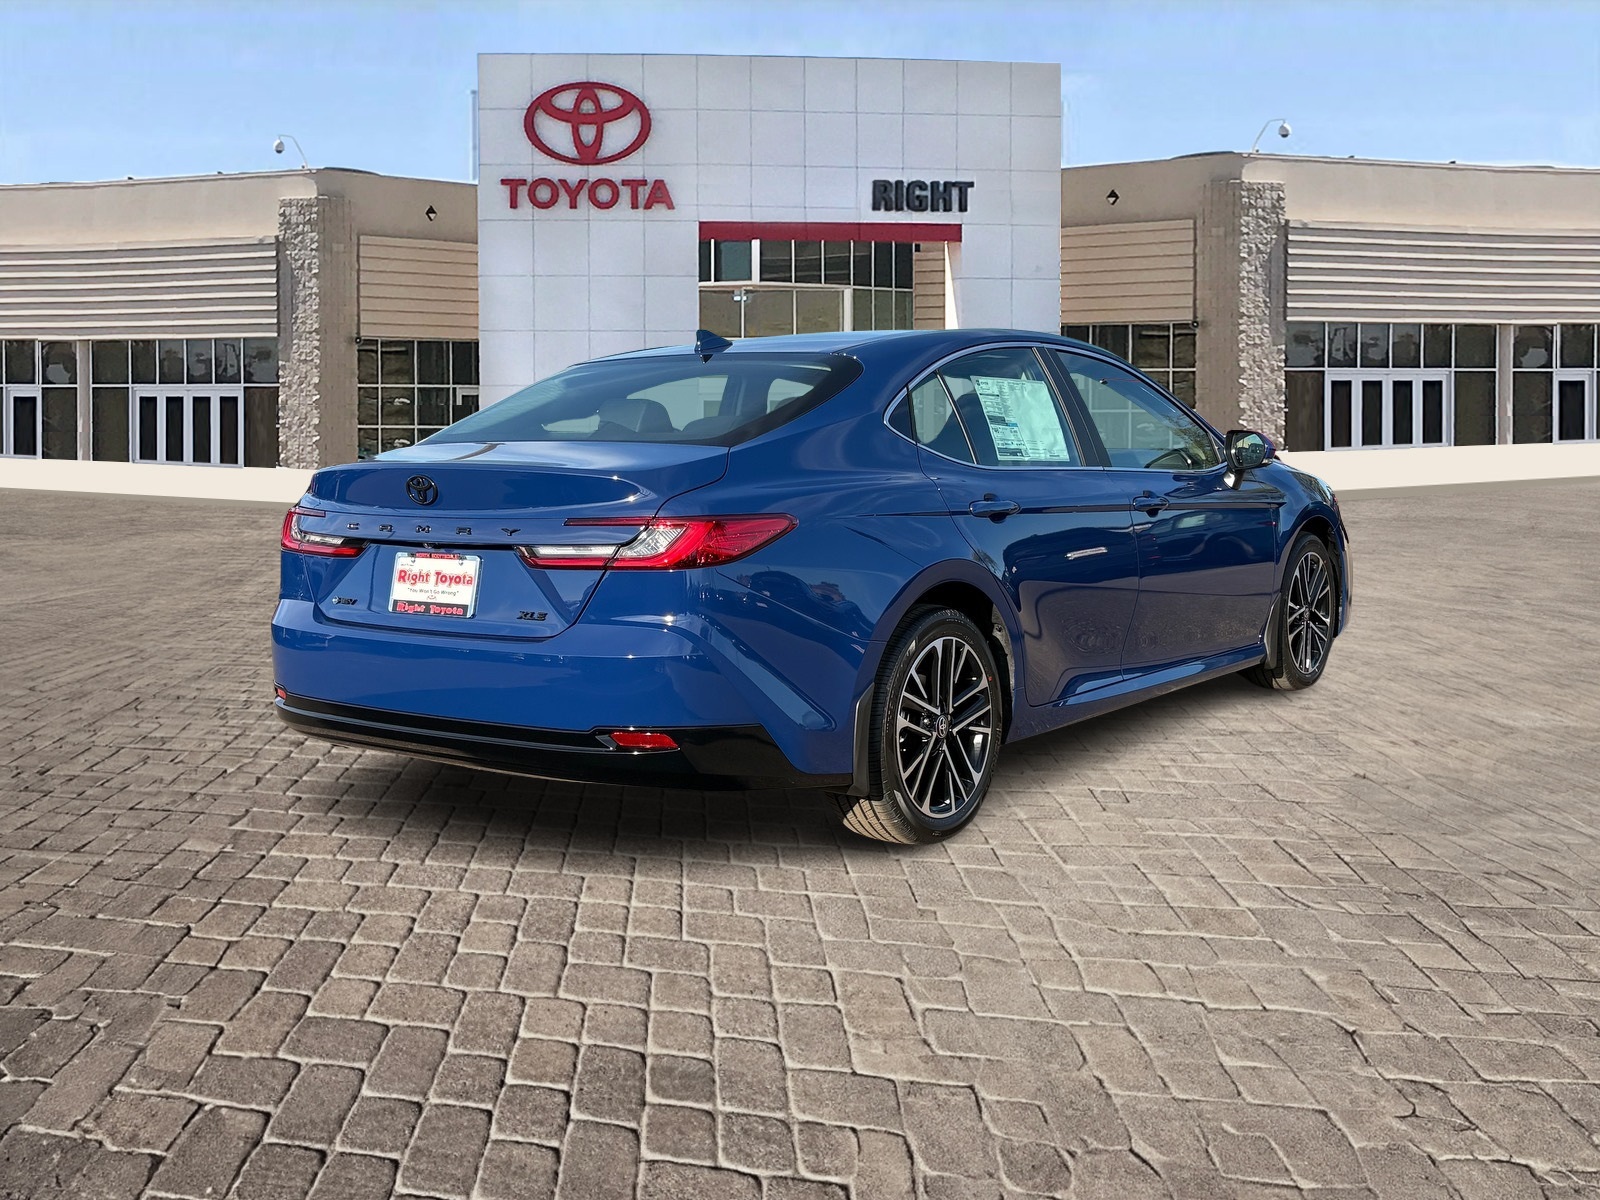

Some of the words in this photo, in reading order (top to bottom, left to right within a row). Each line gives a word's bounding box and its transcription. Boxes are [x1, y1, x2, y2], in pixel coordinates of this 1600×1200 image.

[500, 178, 675, 209] TOYOTA
[872, 180, 974, 212] RIGHT
[397, 569, 430, 585] Right
[434, 571, 474, 587] Toyota
[397, 601, 425, 614] Right
[430, 605, 463, 614] Toyota
[517, 610, 548, 621] XLE
